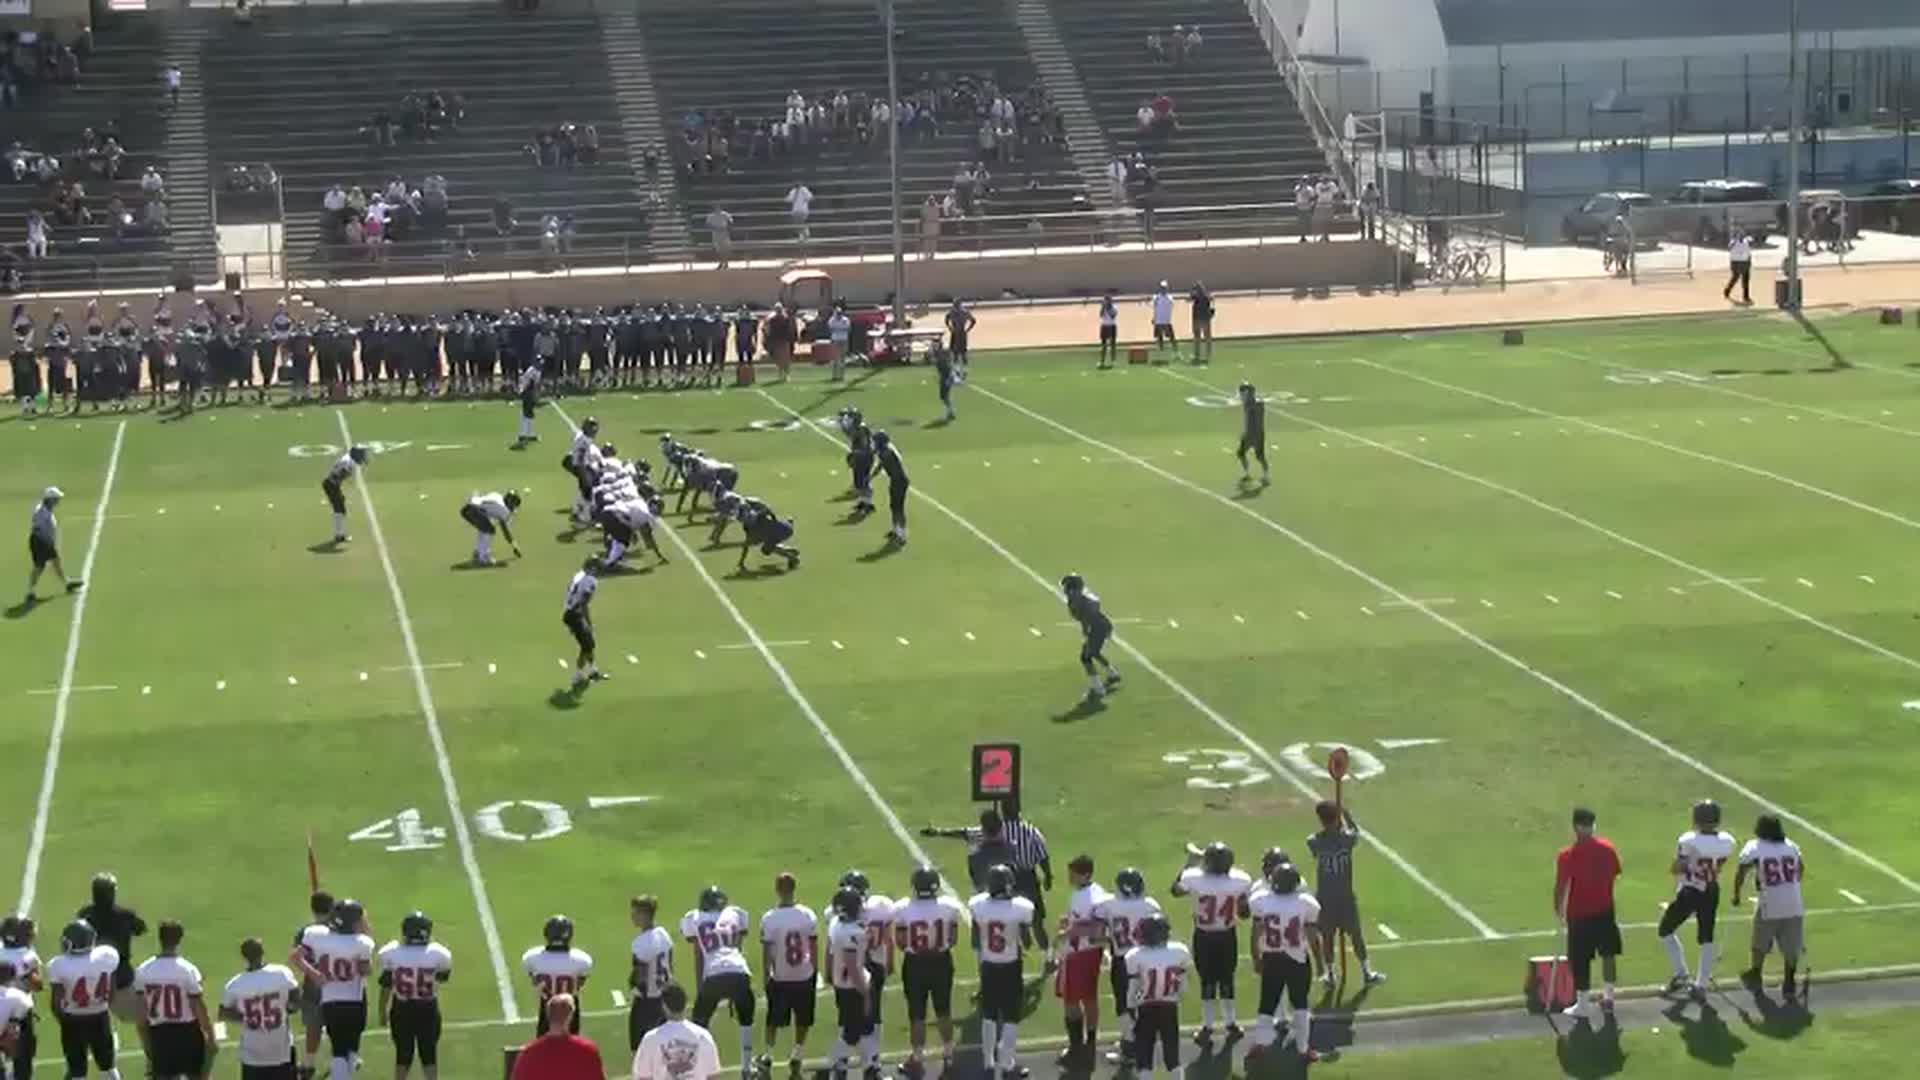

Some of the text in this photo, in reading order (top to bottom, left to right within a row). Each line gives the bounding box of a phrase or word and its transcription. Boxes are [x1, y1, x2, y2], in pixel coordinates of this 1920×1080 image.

[981, 749, 1011, 787] 2
[1162, 742, 1386, 788] 30
[349, 801, 573, 851] 40
[1199, 894, 1238, 926] 34
[785, 930, 804, 966] 8
[988, 920, 1005, 953] 6
[72, 972, 111, 1008] 44
[144, 984, 182, 1020] 70
[243, 992, 282, 1031] 55
